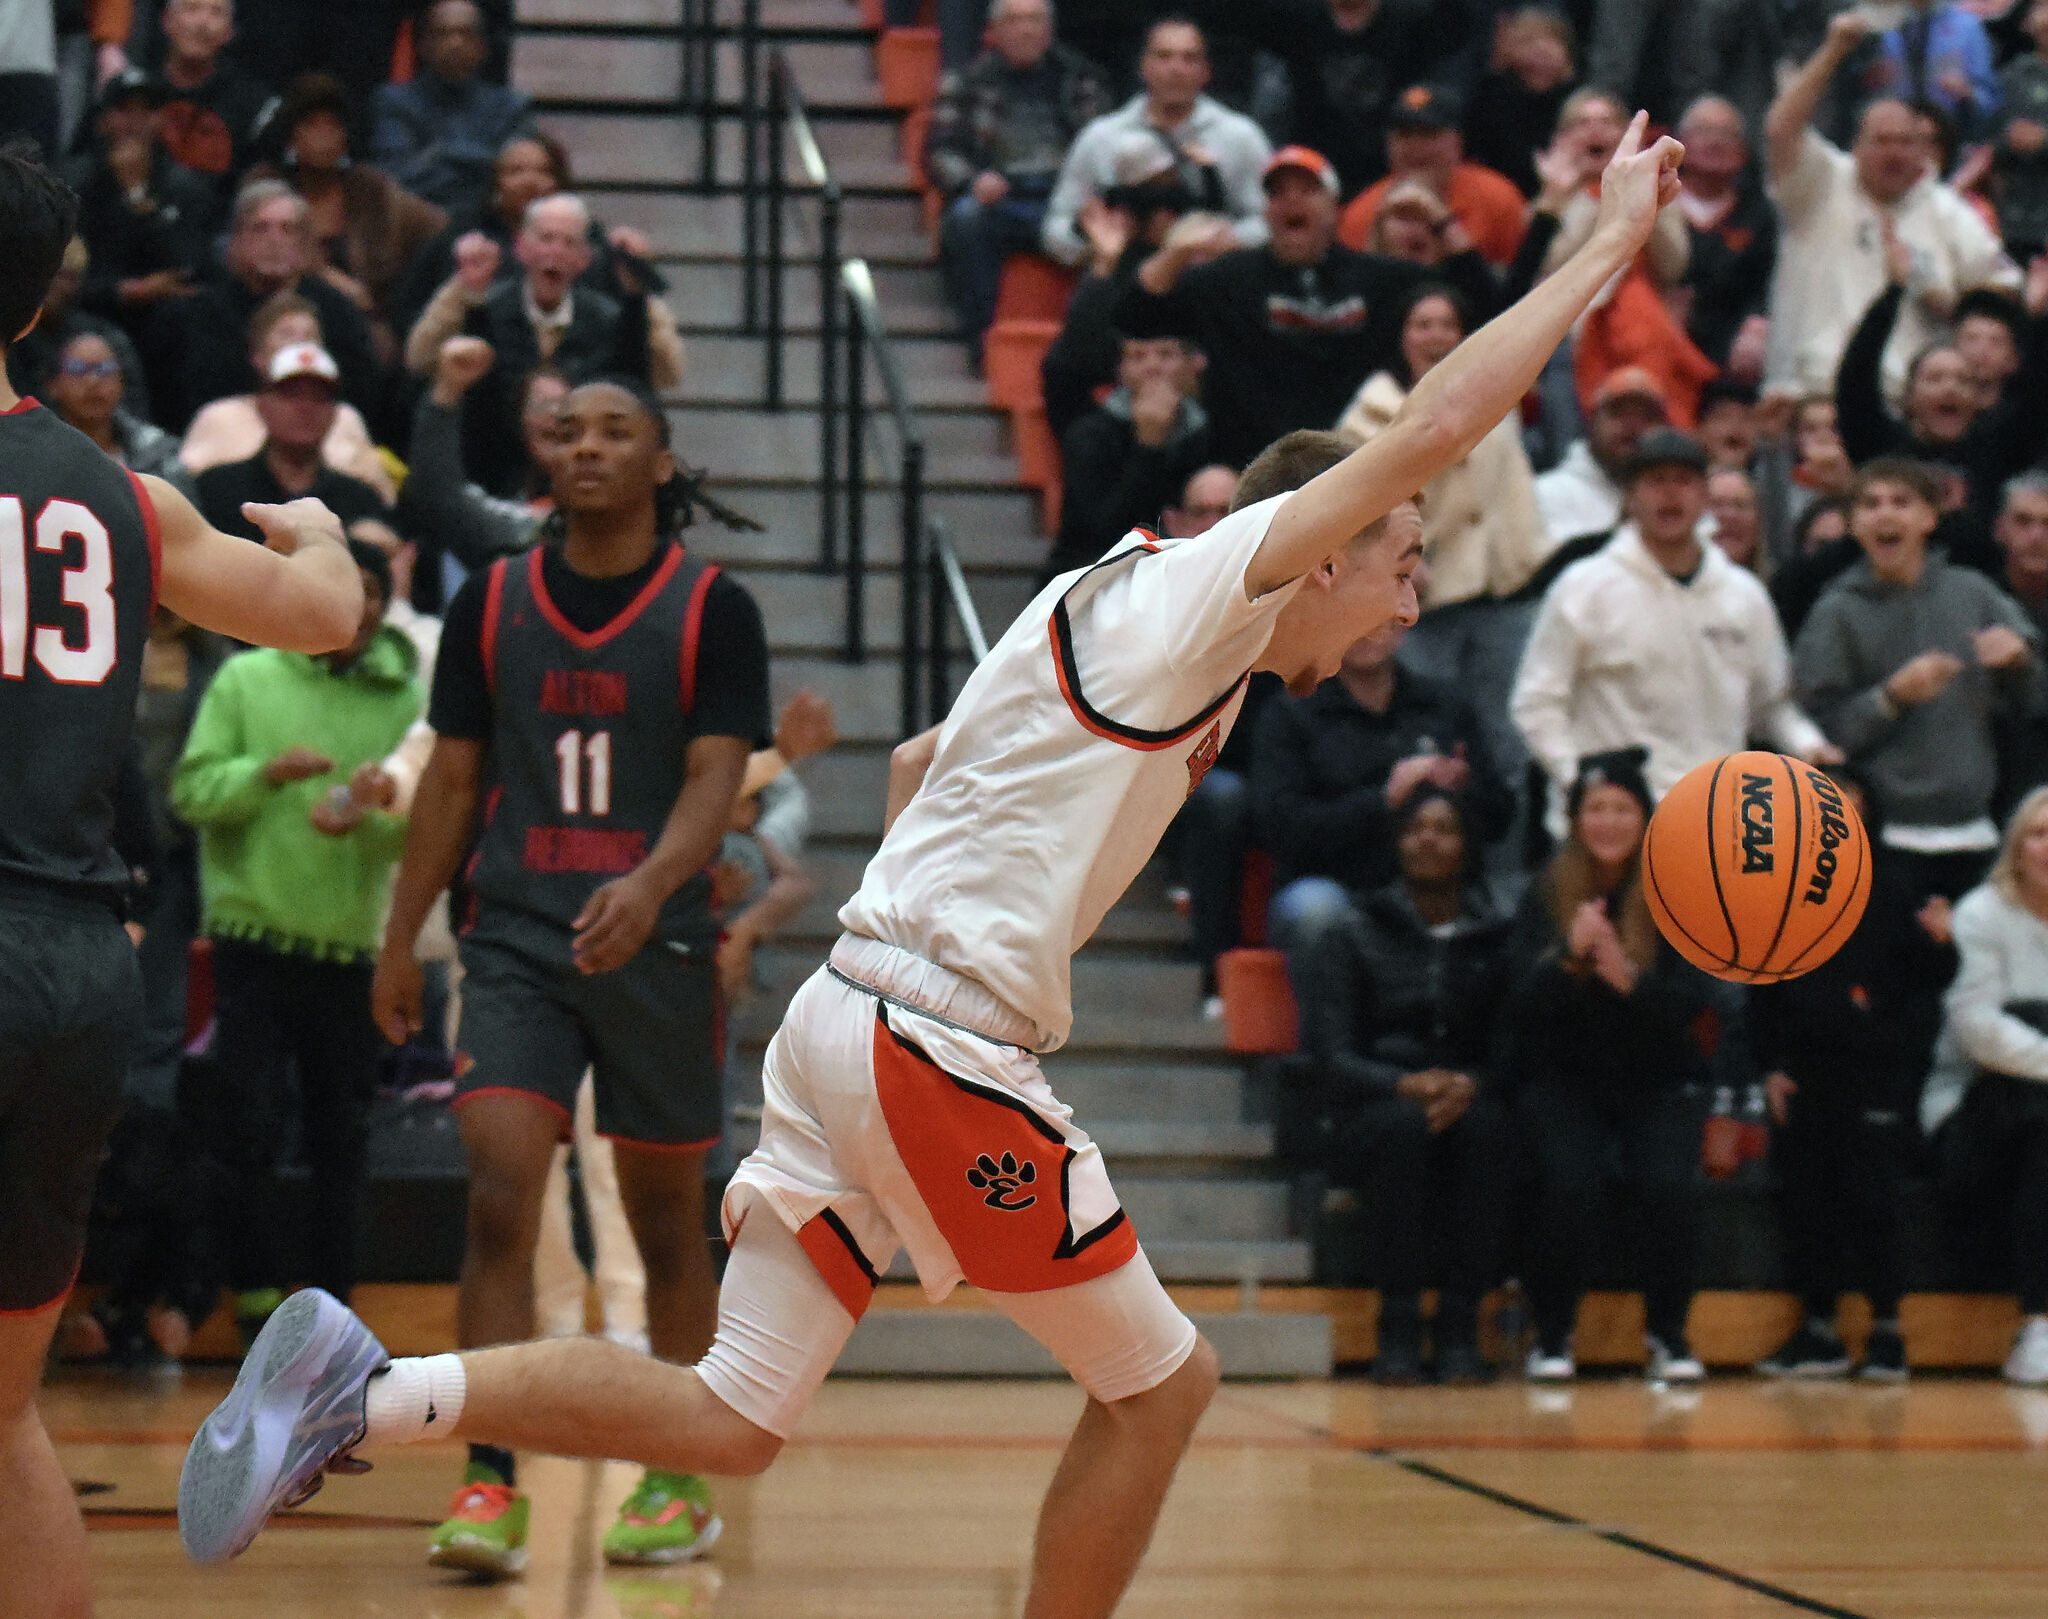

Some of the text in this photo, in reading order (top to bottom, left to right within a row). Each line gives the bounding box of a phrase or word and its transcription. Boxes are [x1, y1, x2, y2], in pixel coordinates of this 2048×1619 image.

[0, 494, 118, 686] 13
[555, 728, 611, 817] 11
[1741, 773, 1774, 875] NCAA
[1805, 771, 1850, 905] Wilson
